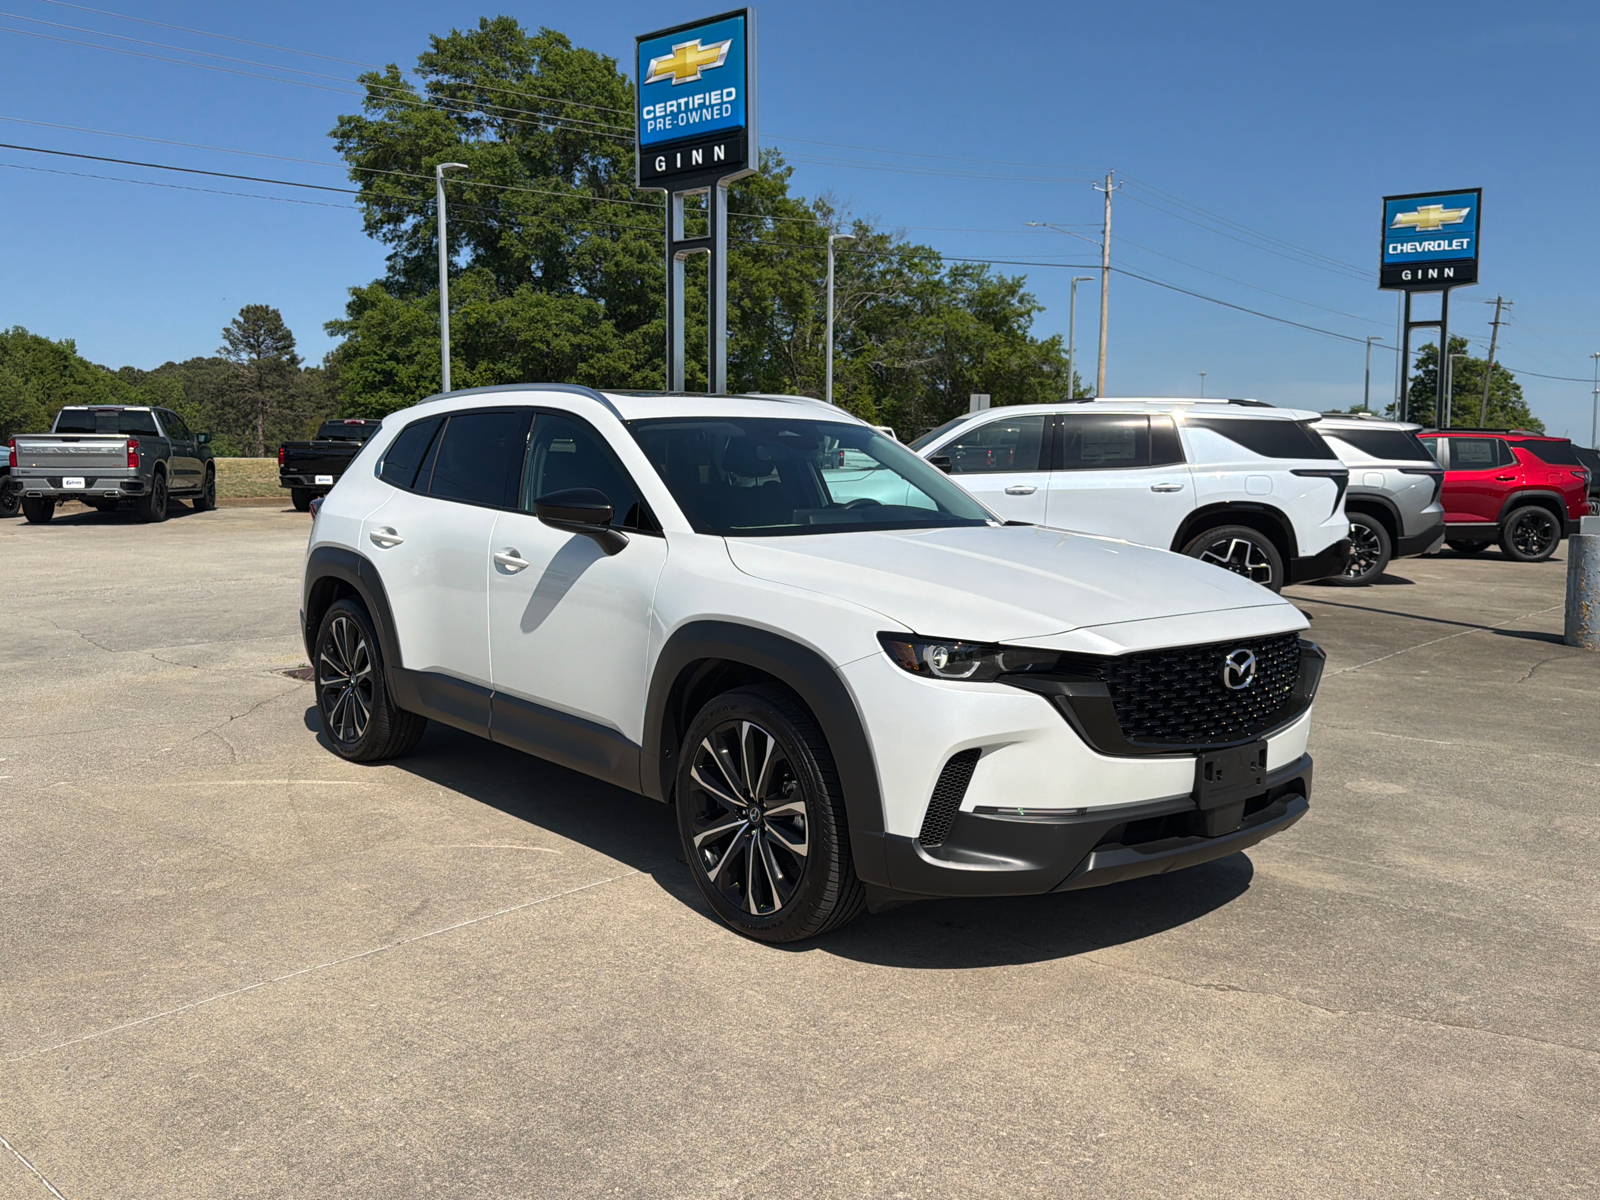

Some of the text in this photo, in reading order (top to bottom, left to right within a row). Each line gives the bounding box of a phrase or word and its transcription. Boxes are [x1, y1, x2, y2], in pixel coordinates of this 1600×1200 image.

[643, 87, 736, 120] CERTIFIED
[648, 104, 731, 132] PRE-OWNED
[655, 145, 724, 171] GINN
[1389, 238, 1470, 254] CHEVROLET
[1401, 267, 1454, 280] GINN
